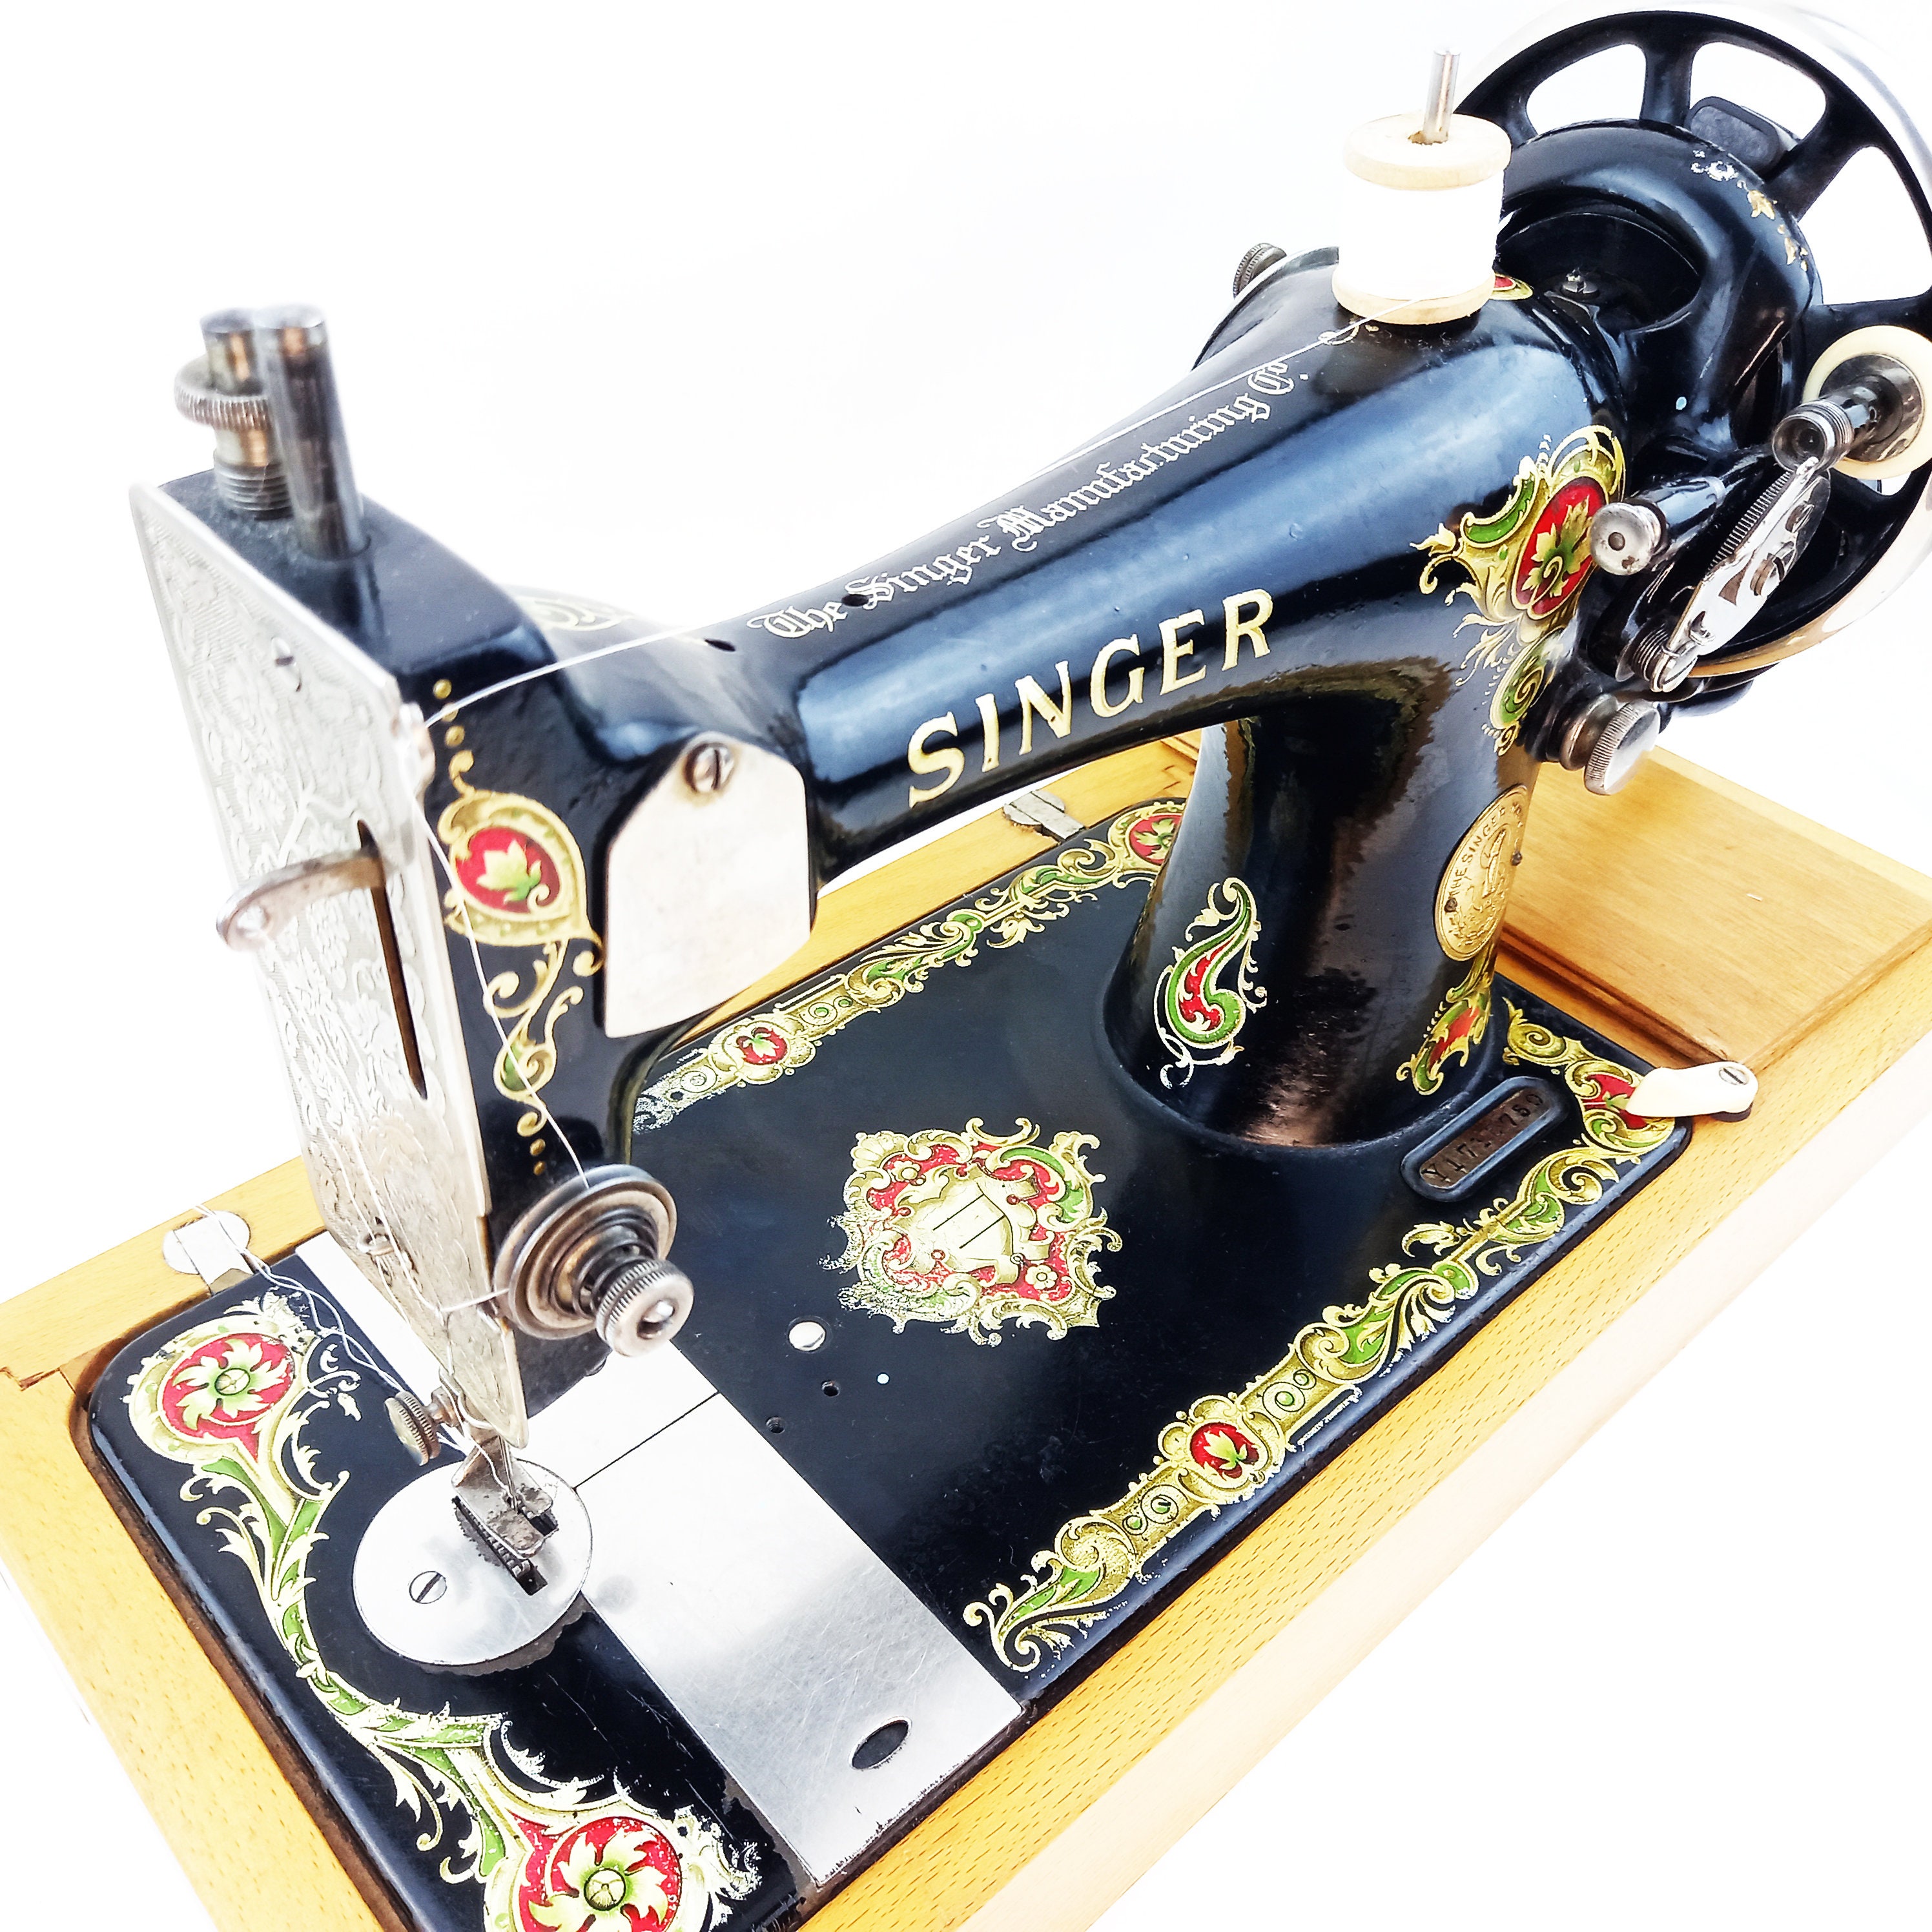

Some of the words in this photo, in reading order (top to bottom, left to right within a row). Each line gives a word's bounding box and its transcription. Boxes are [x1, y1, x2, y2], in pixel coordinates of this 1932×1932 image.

[746, 601, 848, 638] The
[845, 535, 1002, 610] Singer
[976, 392, 1271, 552] Manufacturing
[907, 588, 1274, 808] SINGER
